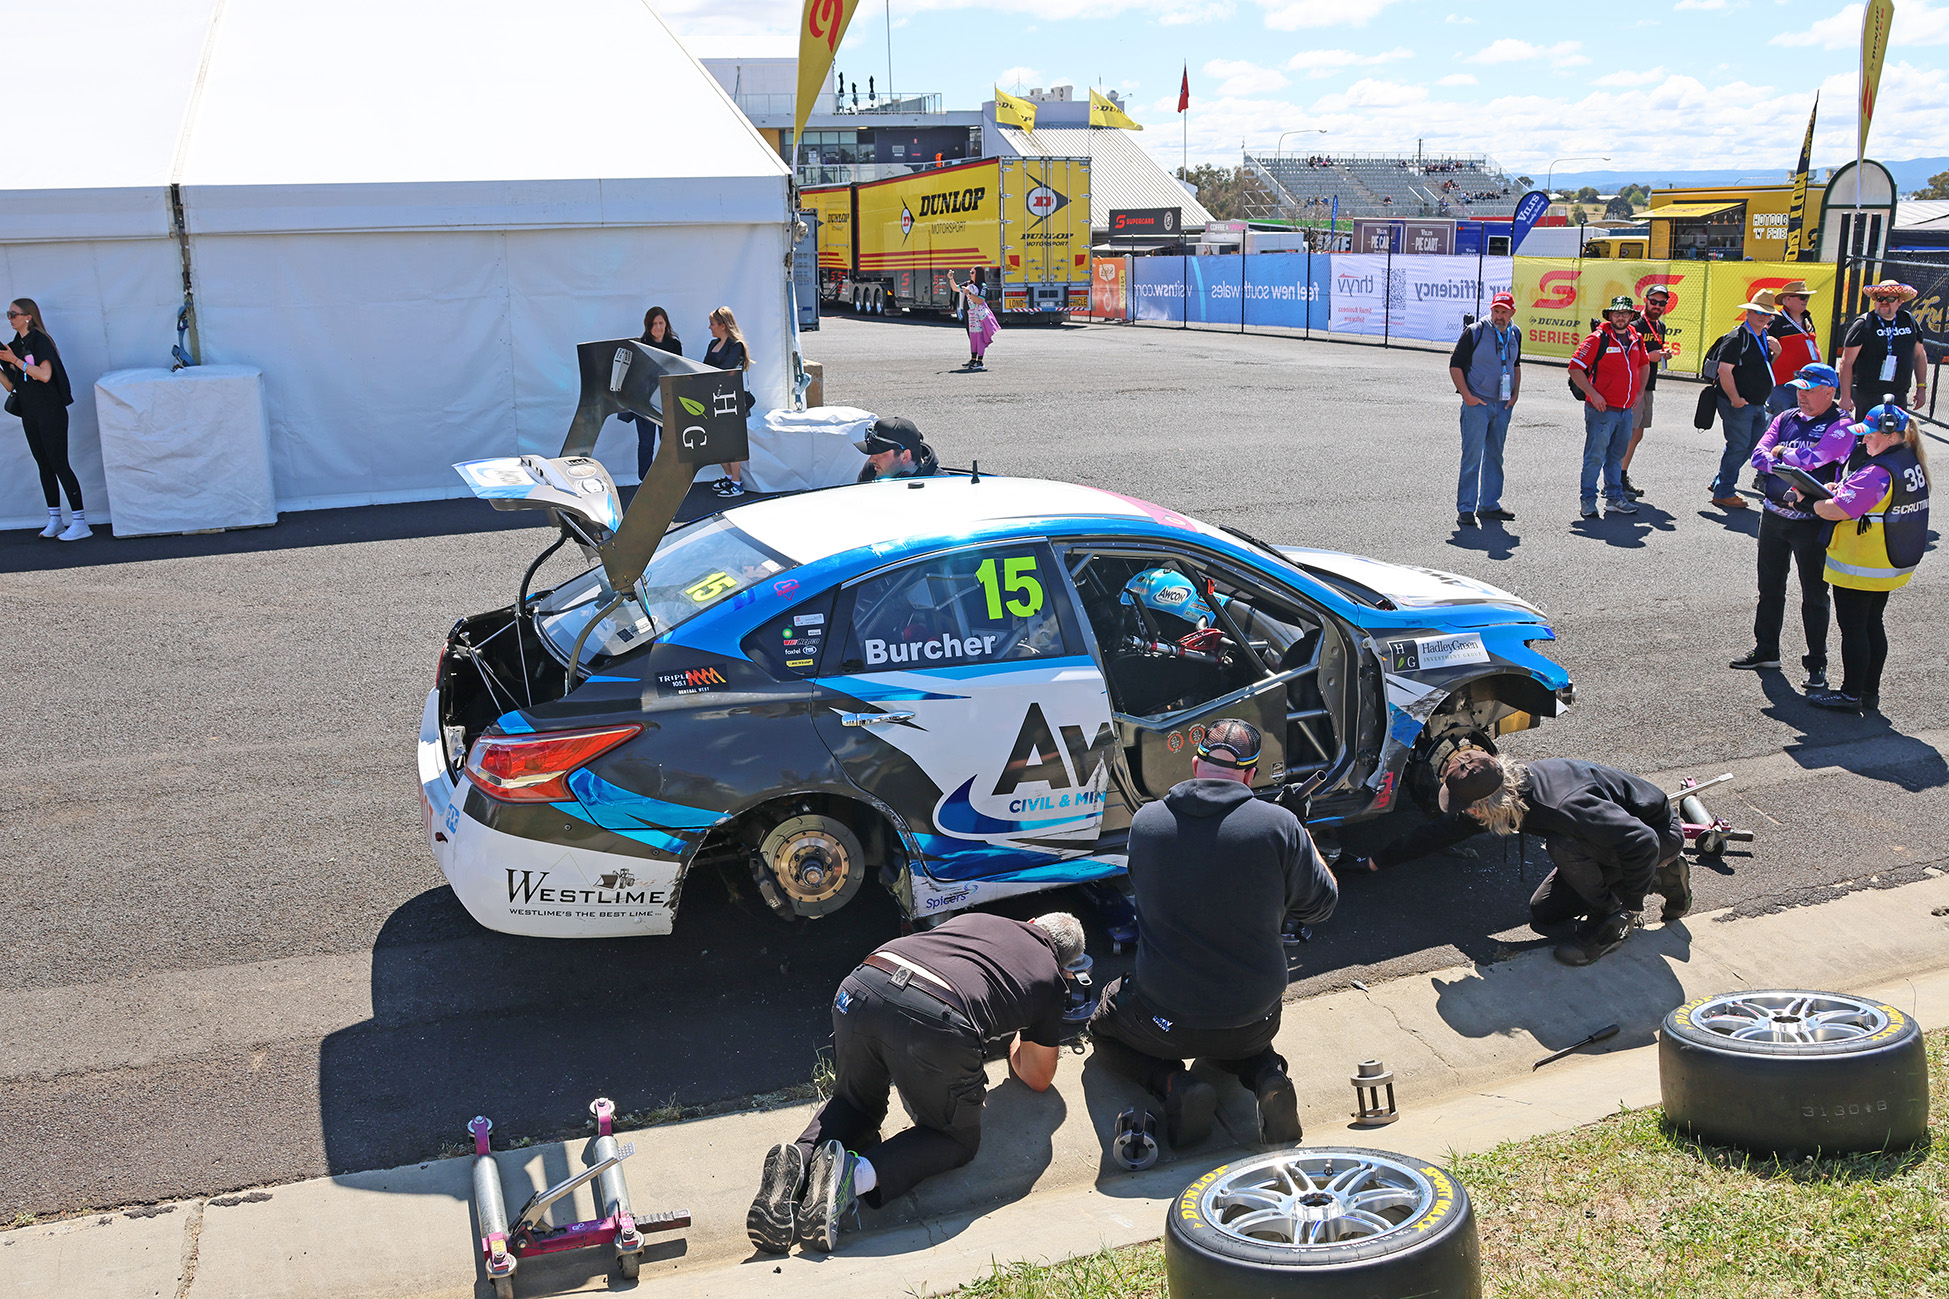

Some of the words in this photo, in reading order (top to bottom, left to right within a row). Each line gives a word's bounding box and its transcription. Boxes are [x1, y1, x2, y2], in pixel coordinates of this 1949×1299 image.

[919, 187, 985, 217] DUNLOP
[931, 221, 967, 235] MOTORSPORT
[1210, 223, 1226, 231] COFFEE
[1020, 233, 1075, 241] DUNLOP
[1370, 235, 1379, 249] PIE
[1414, 237, 1424, 251] PIE
[1423, 237, 1439, 252] CART
[1009, 299, 1024, 308] LONG
[1538, 317, 1581, 328] DUNLOP
[1529, 329, 1580, 346] SERIES
[1904, 464, 1926, 492] 38
[684, 570, 738, 602] 15
[975, 556, 1044, 620] 15
[1159, 586, 1186, 602] AWCON
[864, 633, 996, 665] Burcher
[1423, 654, 1461, 663] INVESTMENT
[1462, 651, 1482, 659] GROUP
[1009, 795, 1055, 814] CIVIL
[1058, 793, 1071, 807] &
[505, 868, 665, 905] WESTLIME
[926, 892, 967, 910] Spicers
[509, 908, 572, 917] WESTLIME'S
[1675, 995, 1714, 1026] DUNLOP
[1181, 1164, 1229, 1220] DUNLOP
[1419, 1166, 1454, 1200] SPORT
[1411, 1199, 1453, 1233] MAXX
